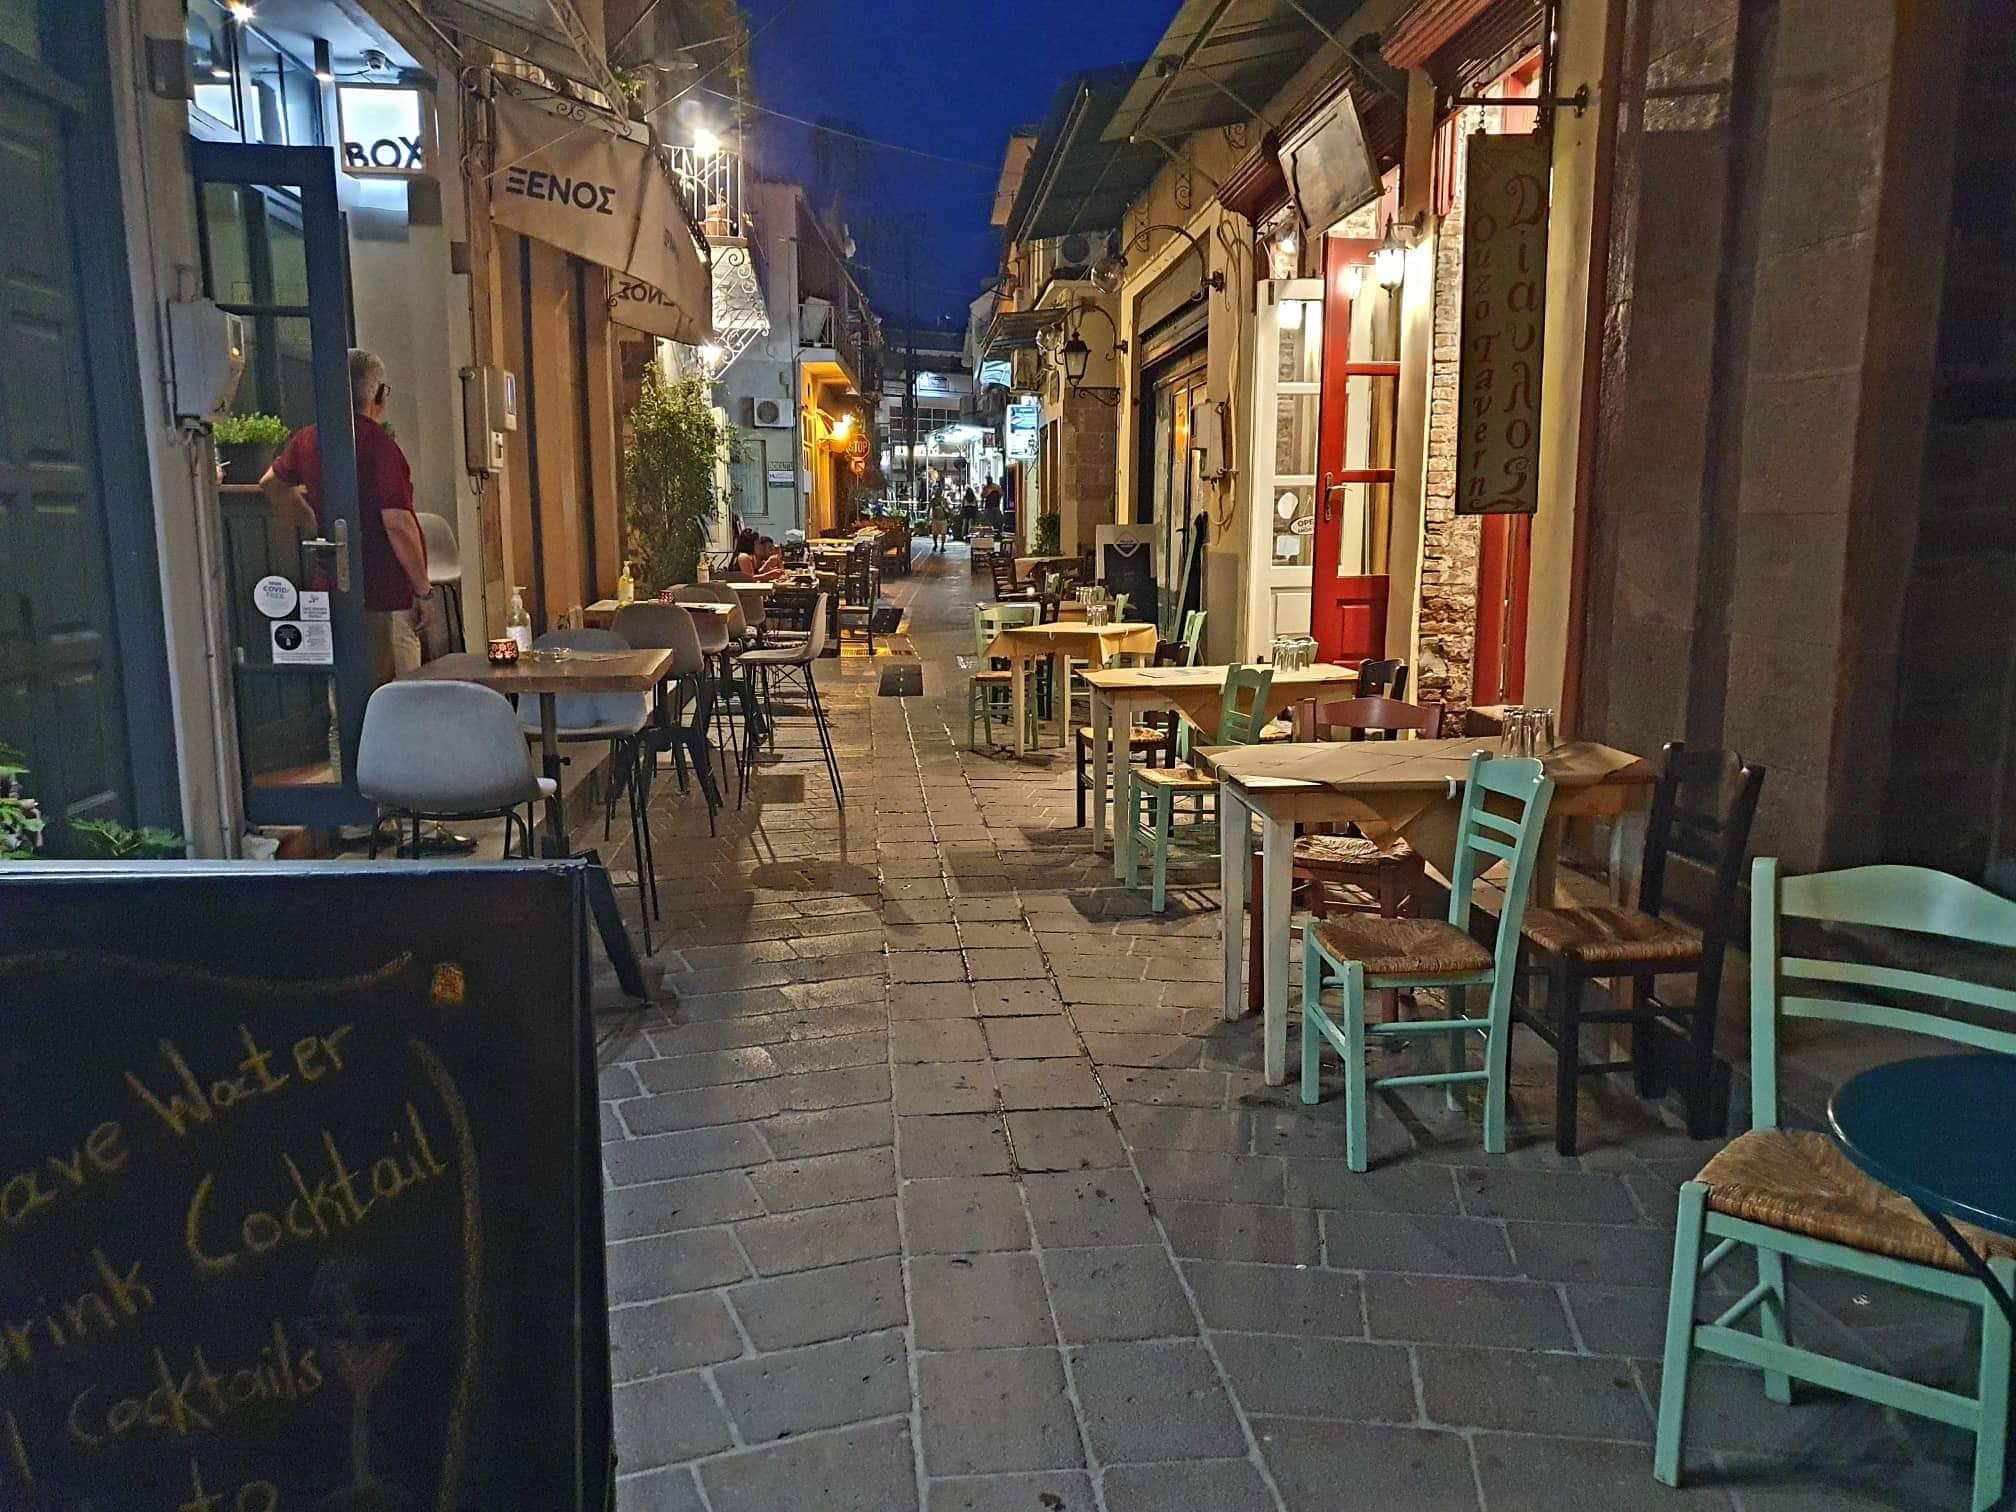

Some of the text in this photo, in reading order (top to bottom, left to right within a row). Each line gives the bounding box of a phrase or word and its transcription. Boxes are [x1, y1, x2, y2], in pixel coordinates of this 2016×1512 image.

[344, 134, 423, 168] BOX
[506, 166, 616, 215] ΞΕΝΟΣ
[848, 440, 868, 454] STOP
[1469, 332, 1499, 496] Tavern
[124, 1024, 355, 1137] Water
[185, 1101, 449, 1272] Cocktail
[68, 1316, 322, 1445] Cocktails
